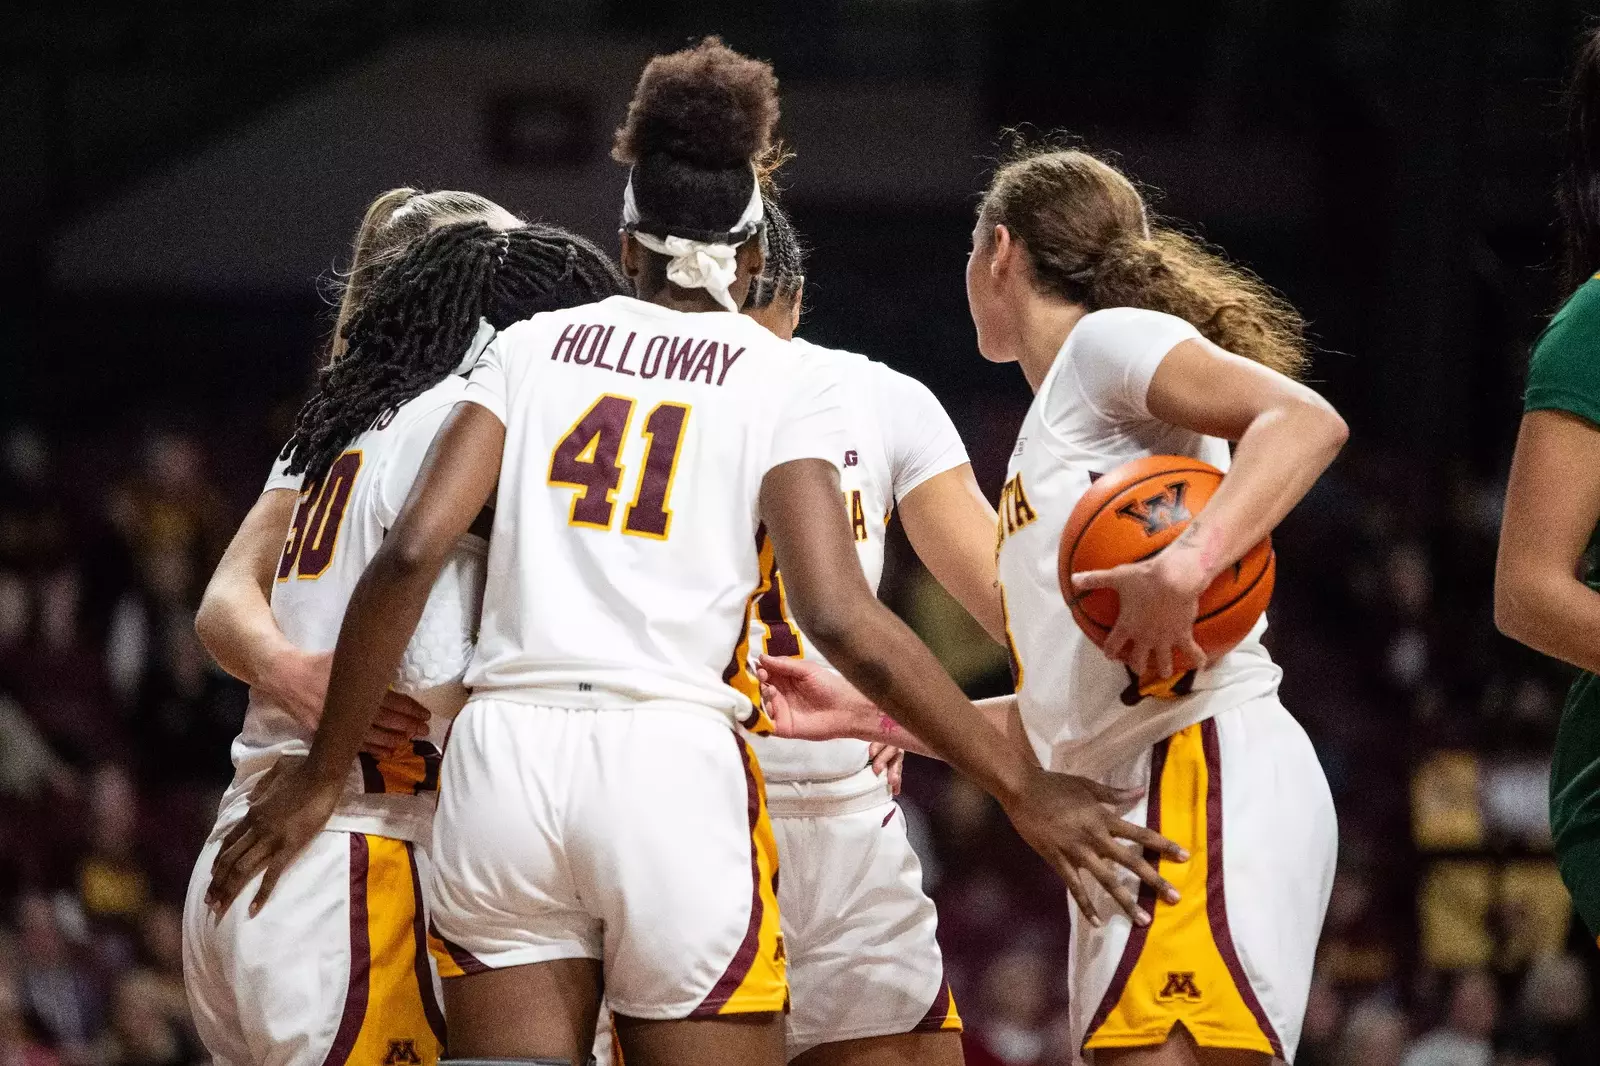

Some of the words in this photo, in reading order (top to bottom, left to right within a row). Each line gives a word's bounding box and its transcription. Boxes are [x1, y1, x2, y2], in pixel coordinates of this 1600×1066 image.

[551, 324, 746, 386] HOLLOWAY
[547, 393, 692, 541] 41
[998, 471, 1038, 543] TA
[1158, 971, 1202, 1001] M
[385, 1038, 424, 1066] M
